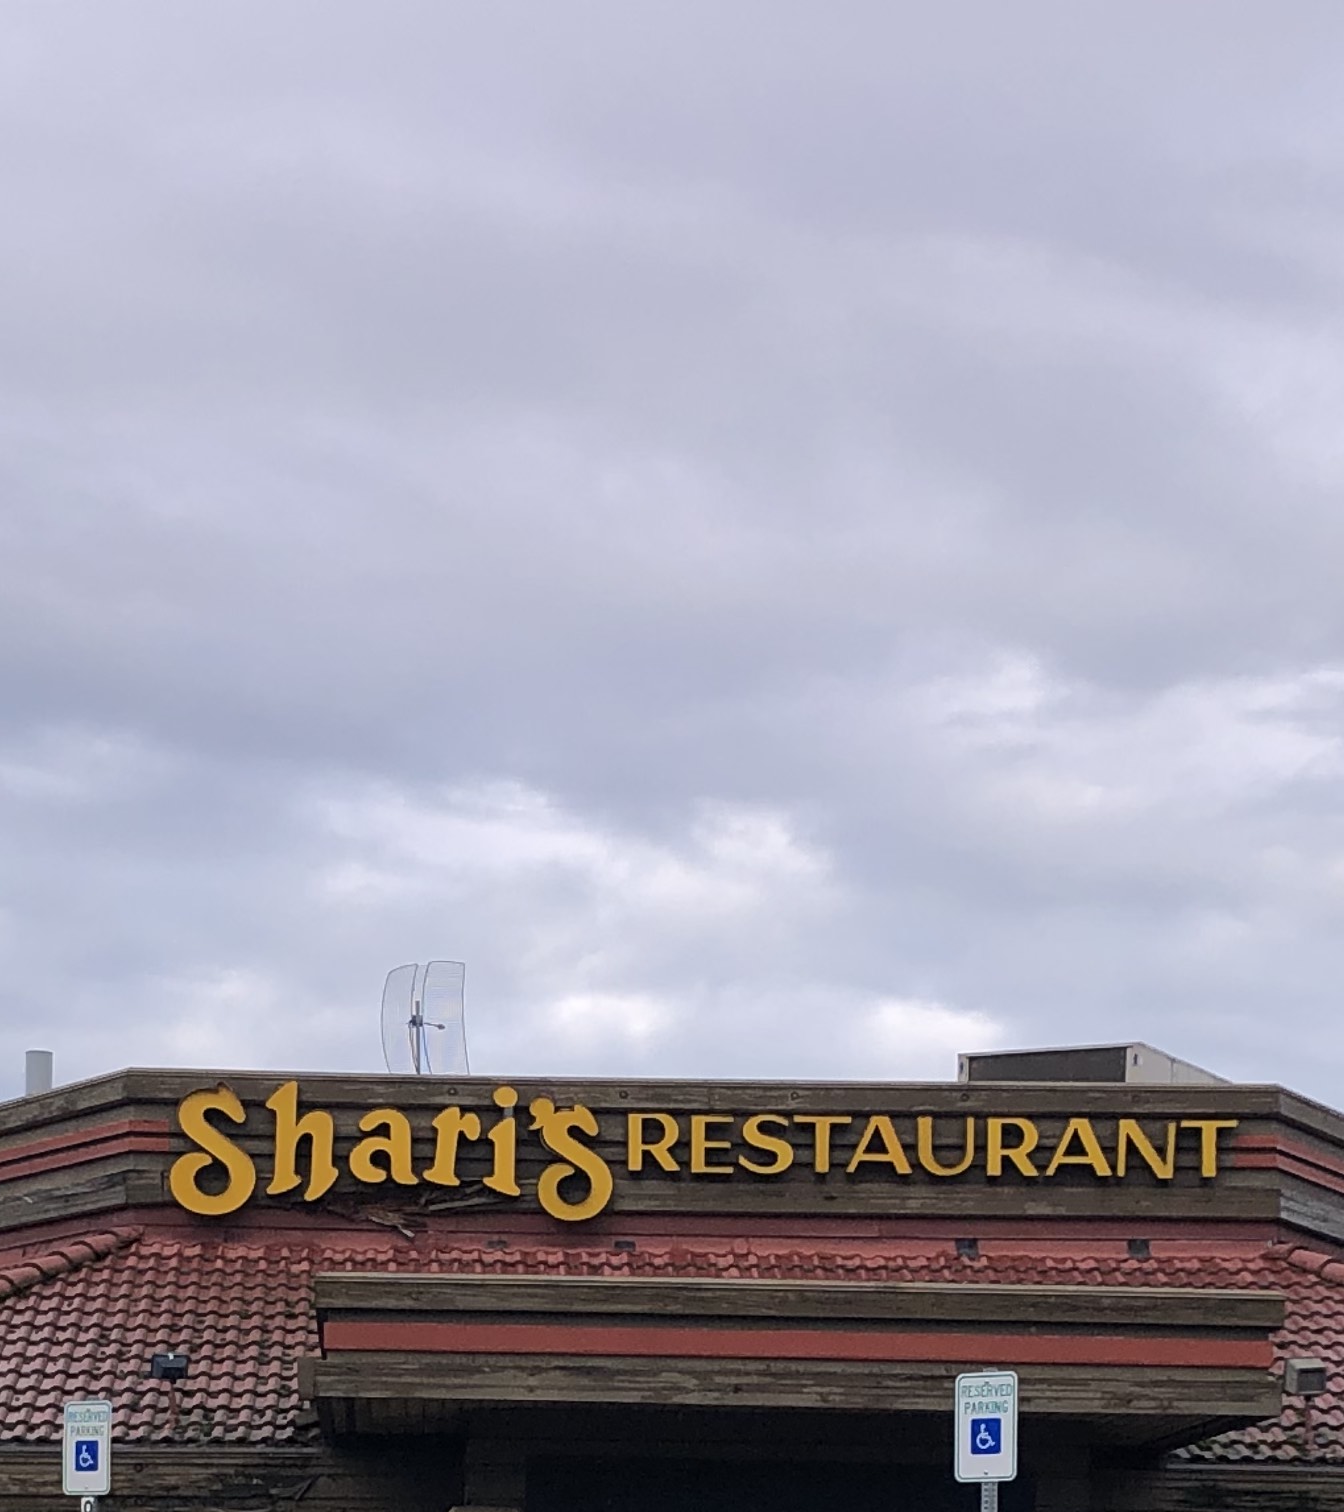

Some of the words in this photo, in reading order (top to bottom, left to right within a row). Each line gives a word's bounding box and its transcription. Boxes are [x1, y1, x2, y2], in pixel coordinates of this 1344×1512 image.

[169, 1081, 613, 1221] Shari's
[627, 1113, 1239, 1180] RESTAURANT
[961, 1384, 1012, 1397] RESERVED
[964, 1400, 1009, 1415] PARKING
